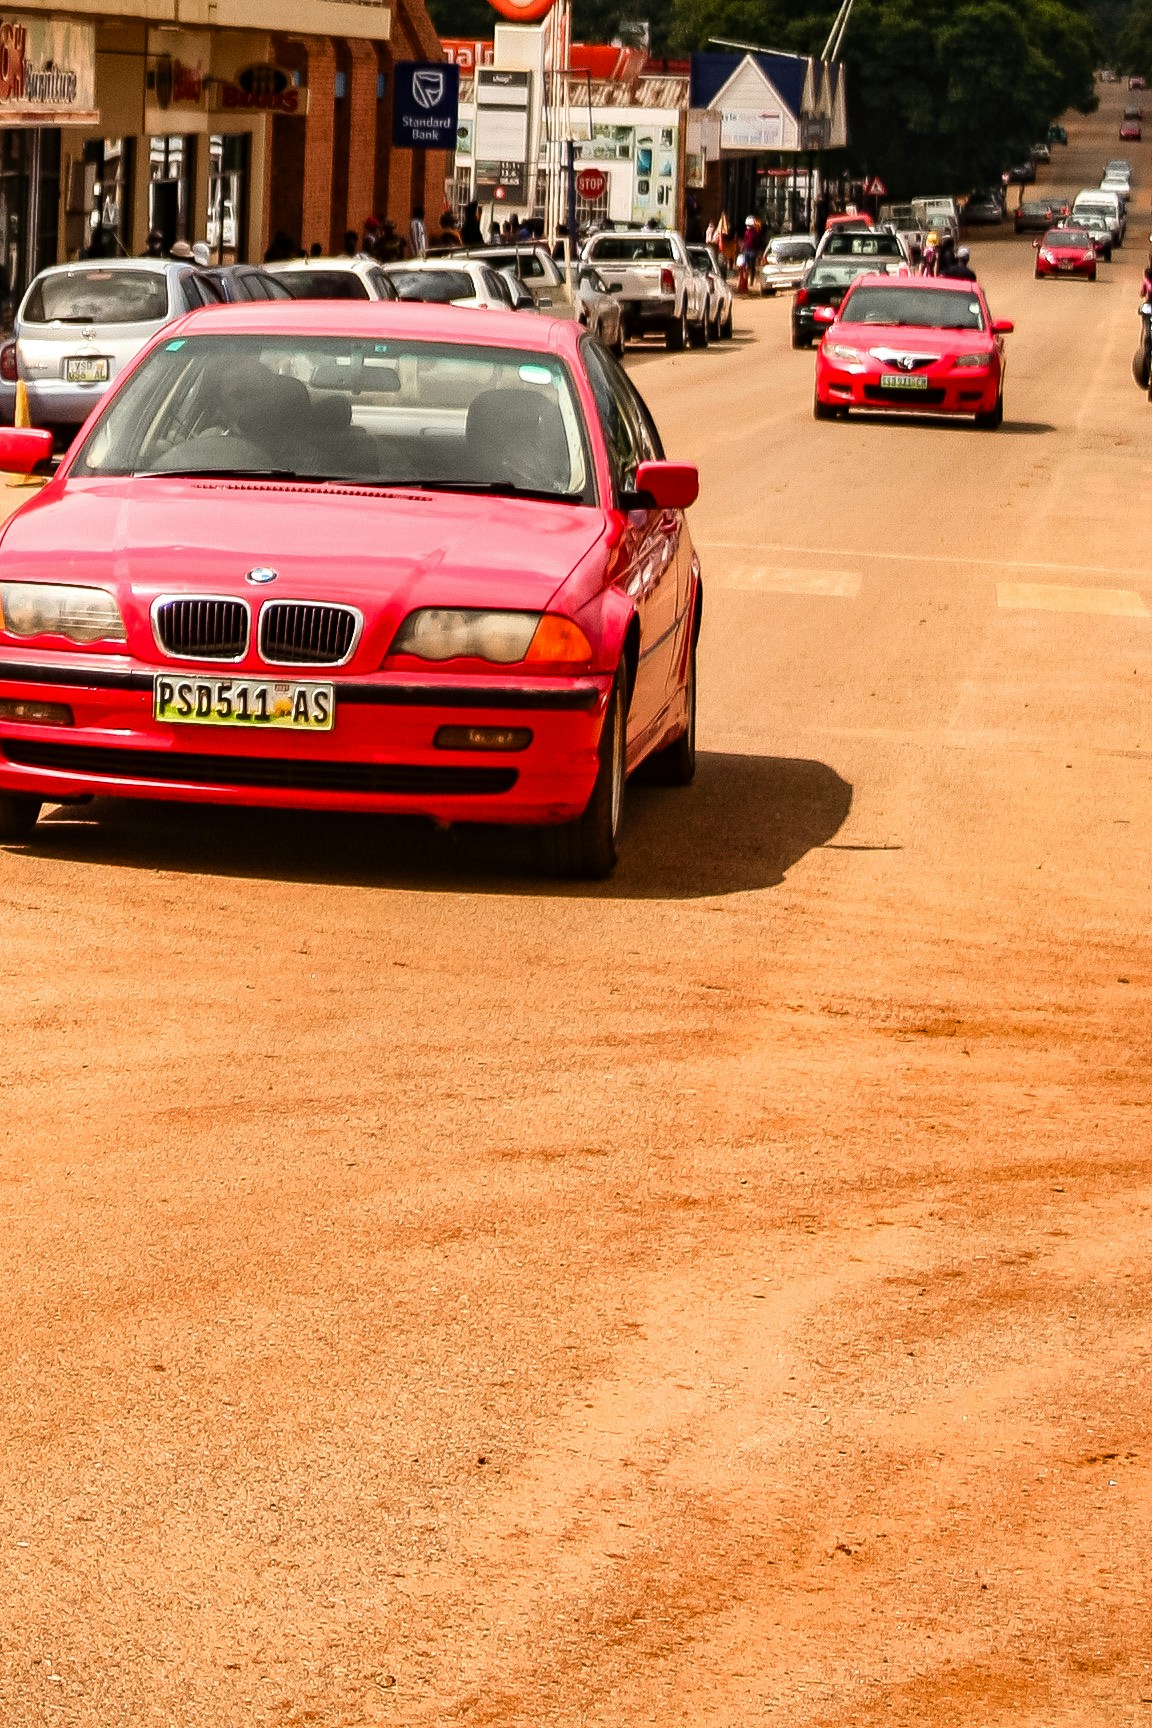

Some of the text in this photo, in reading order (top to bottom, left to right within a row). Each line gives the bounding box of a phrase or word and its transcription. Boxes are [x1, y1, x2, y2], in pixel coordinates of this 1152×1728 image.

[402, 116, 451, 128] Standard
[412, 129, 439, 140] Bank
[578, 178, 603, 190] STOP
[293, 687, 329, 723] AS
